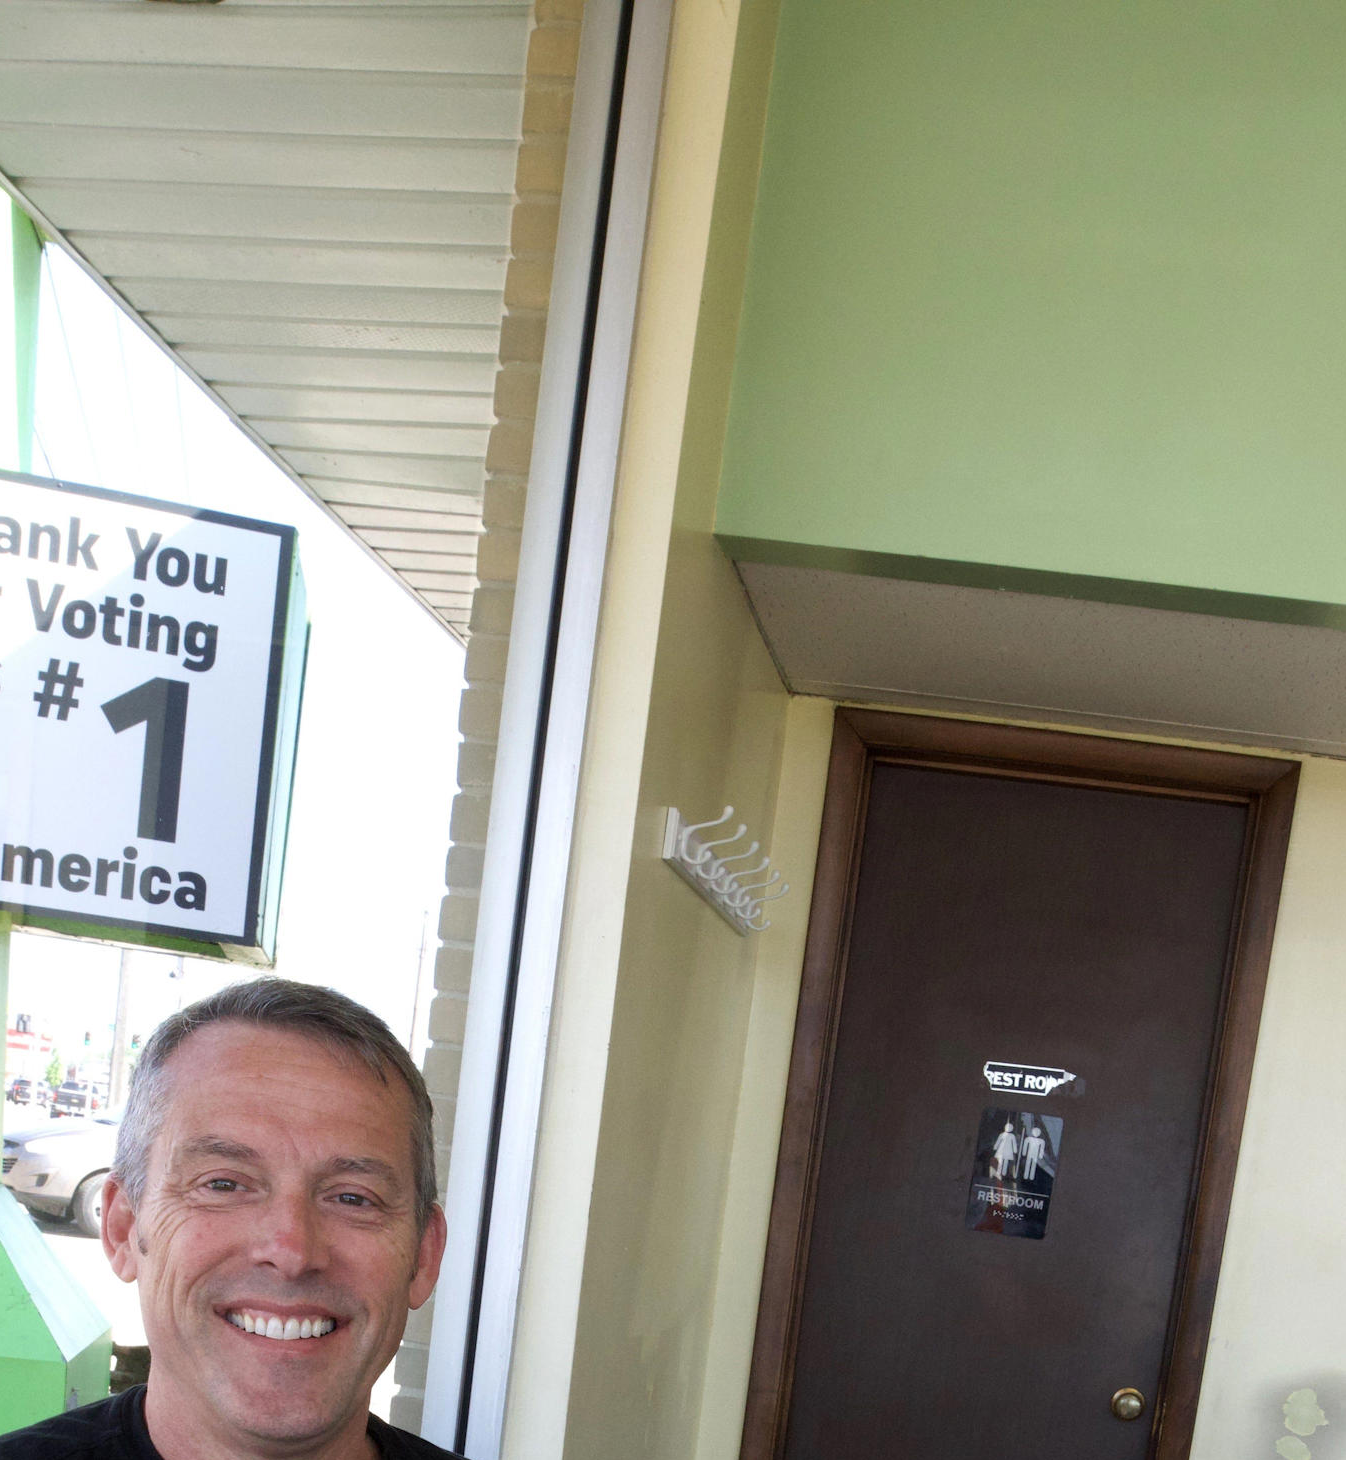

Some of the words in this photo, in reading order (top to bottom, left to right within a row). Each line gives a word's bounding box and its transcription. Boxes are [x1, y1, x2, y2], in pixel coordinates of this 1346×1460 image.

[125, 526, 229, 597] You
[26, 577, 219, 673] Voting
[977, 1190, 1044, 1210] RESTROOM
